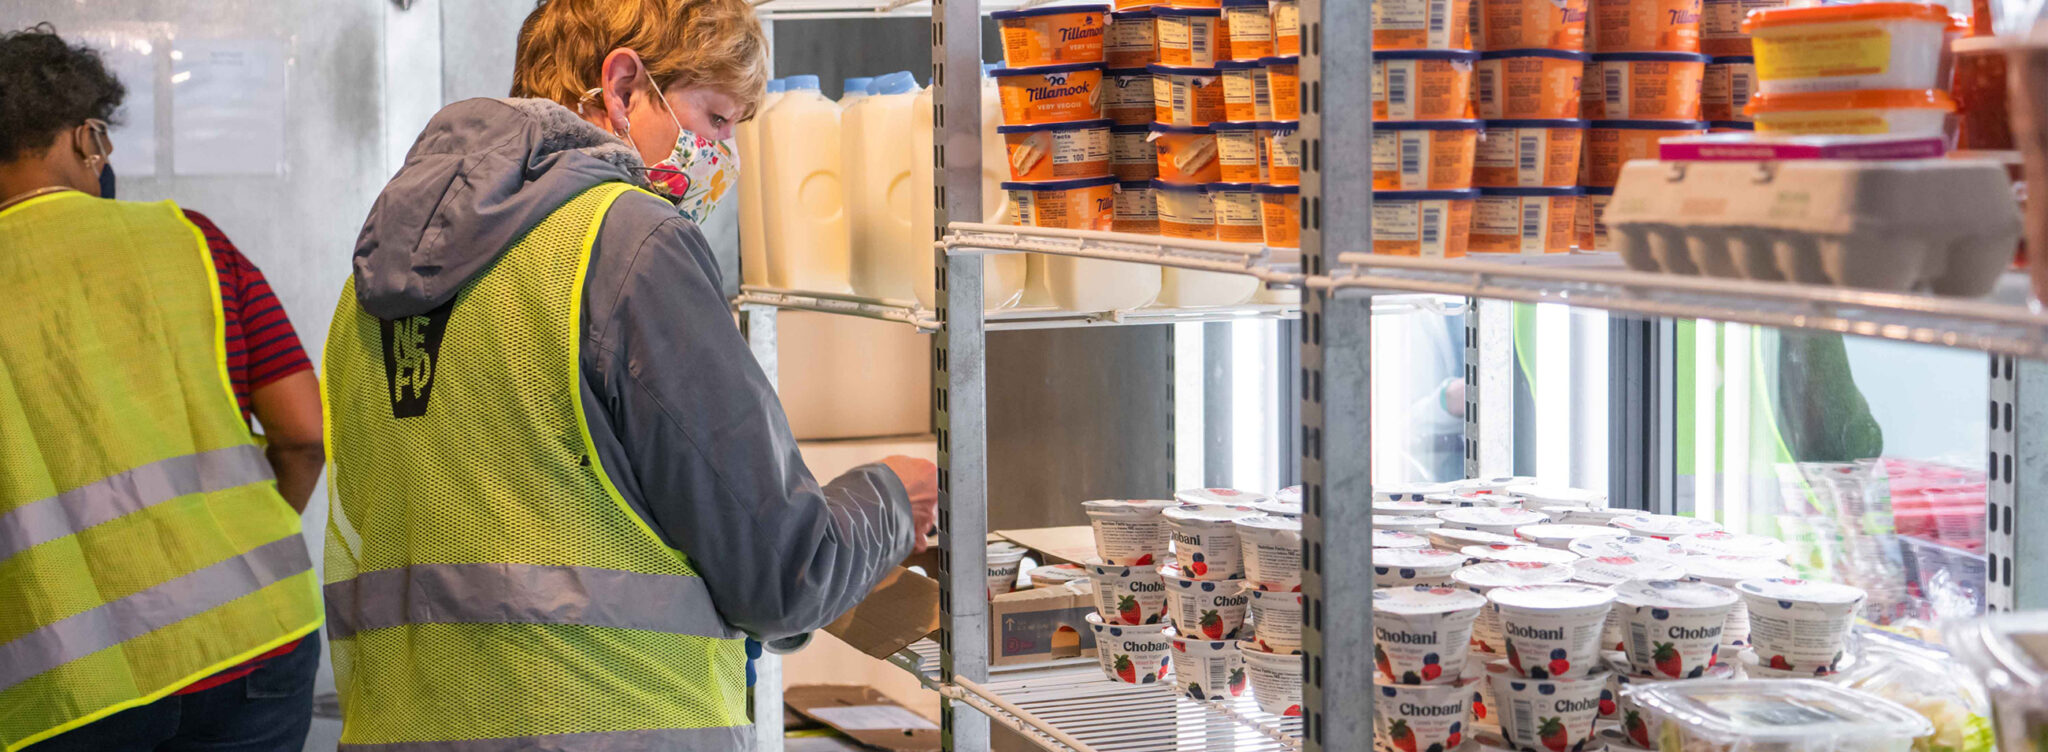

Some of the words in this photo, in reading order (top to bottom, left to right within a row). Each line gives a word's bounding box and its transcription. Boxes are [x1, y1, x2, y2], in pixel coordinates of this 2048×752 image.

[1026, 81, 1090, 102] Tillamook
[1037, 103, 1055, 111] VERY
[1073, 153, 1085, 162] 100
[1376, 626, 1437, 645] Chobani
[1505, 621, 1564, 640] Chobani
[1668, 625, 1721, 639] Choban
[1399, 699, 1463, 717] Chobani
